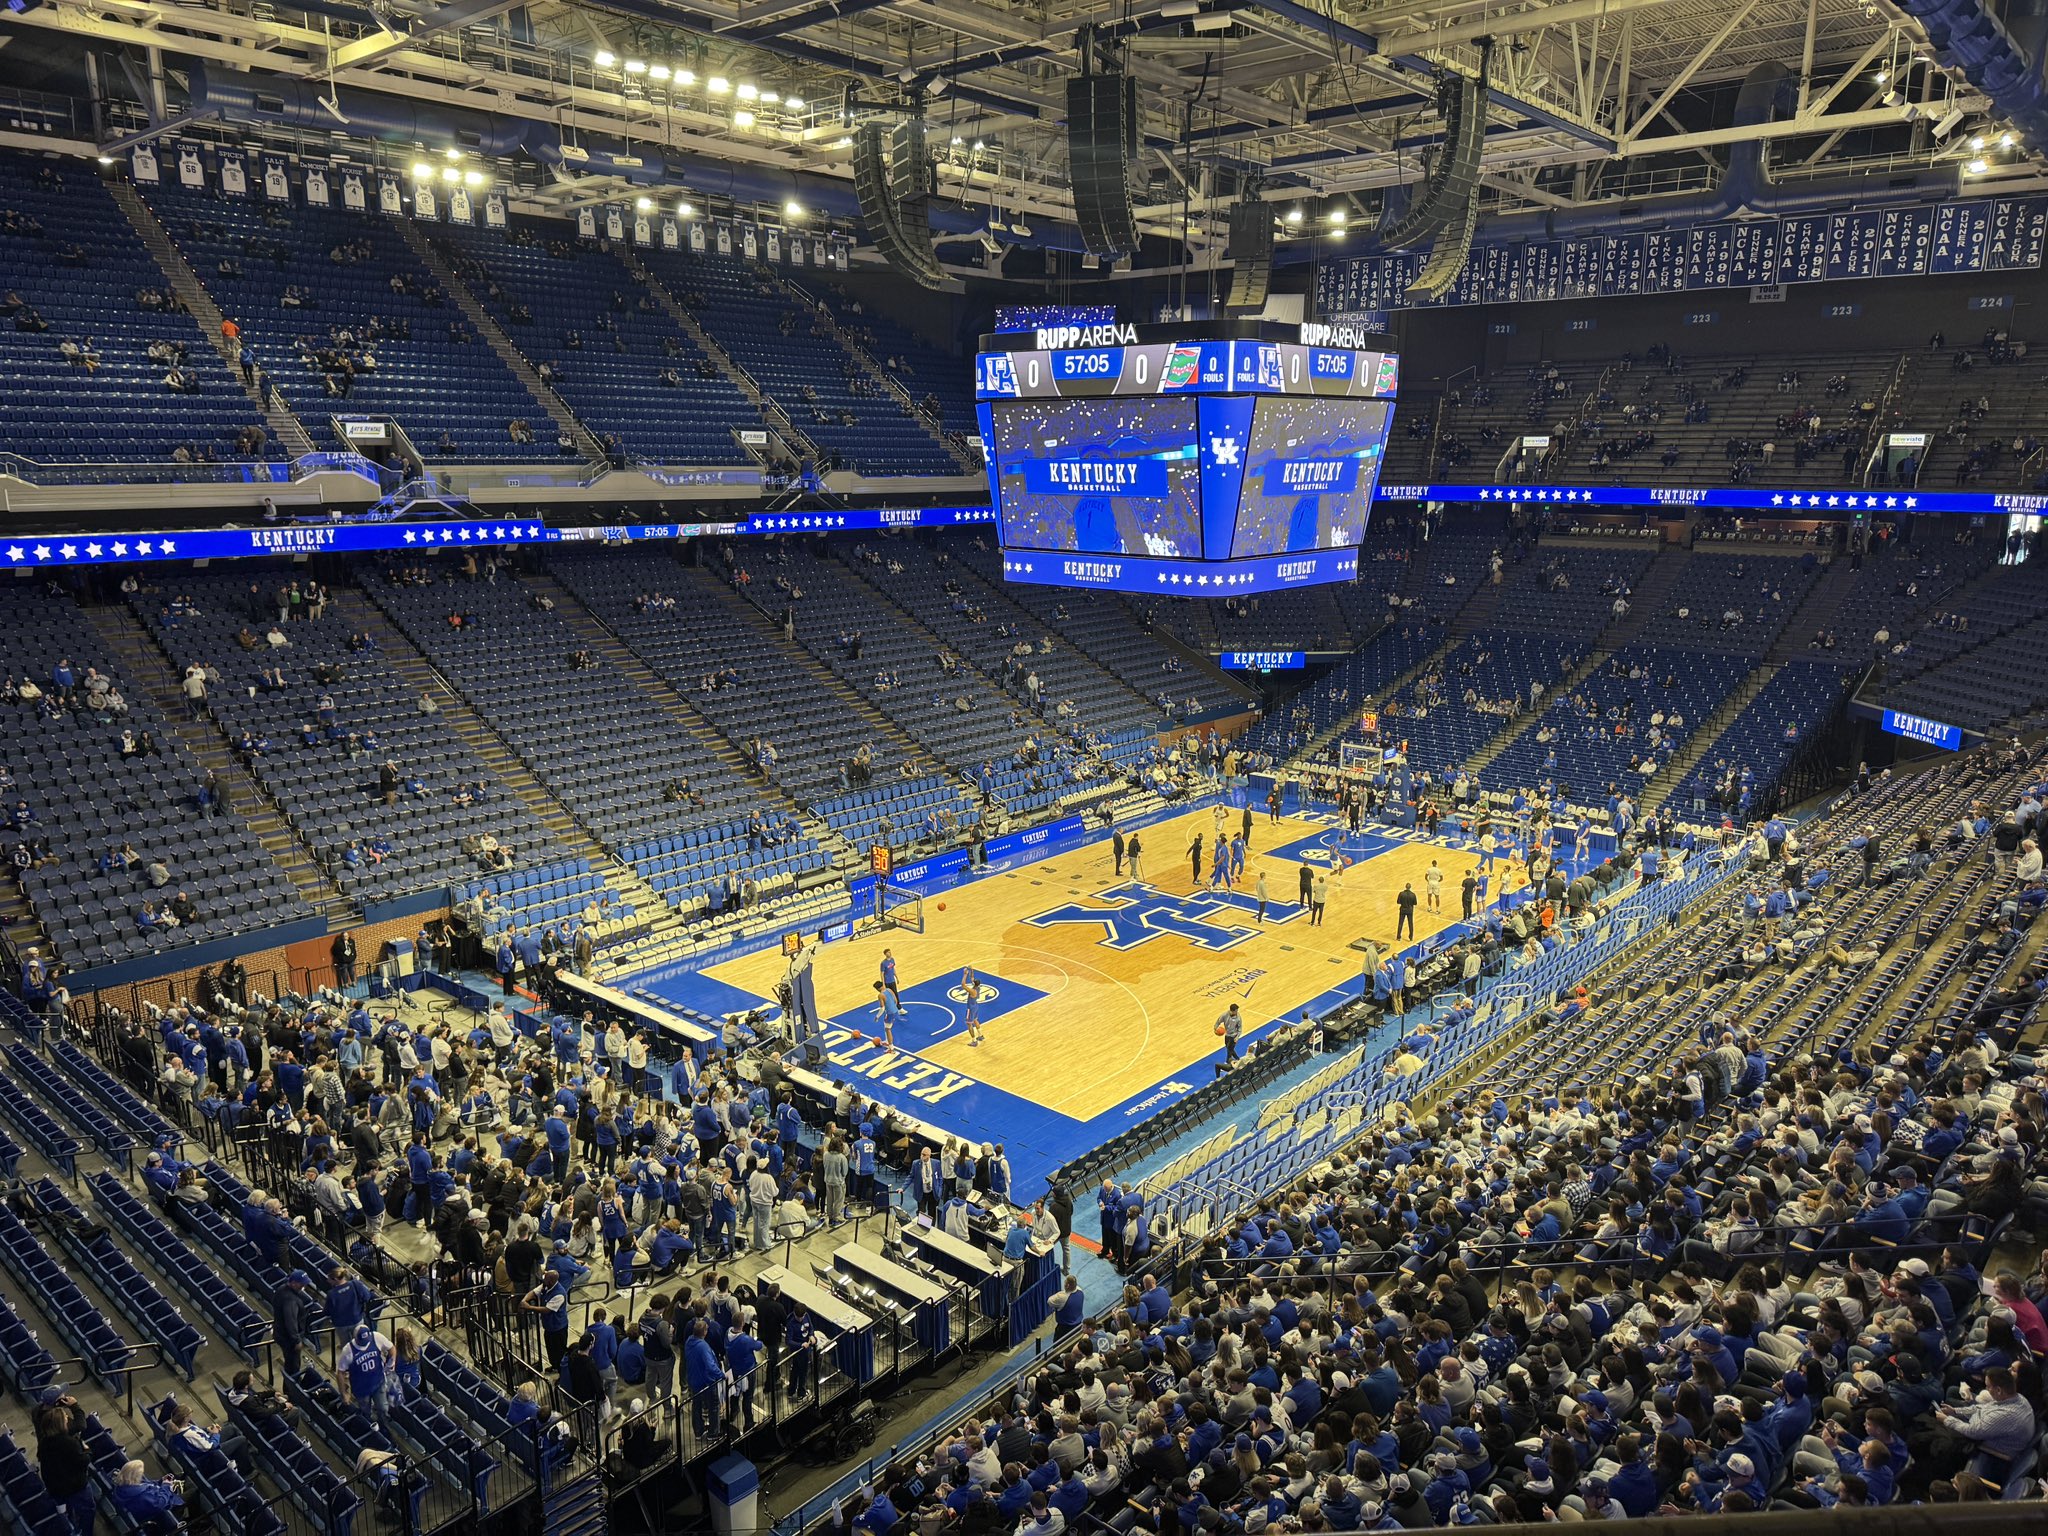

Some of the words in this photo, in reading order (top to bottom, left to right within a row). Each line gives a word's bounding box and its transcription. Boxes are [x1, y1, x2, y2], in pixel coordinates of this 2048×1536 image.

[219, 150, 245, 160] SPICER
[265, 157, 285, 165] SALE
[186, 165, 196, 174] 56
[272, 177, 280, 185] 19
[377, 172, 399, 180] BEARD
[314, 183, 320, 191] 7
[351, 187, 357, 195] 4
[386, 192, 394, 200] 12
[1957, 209, 1970, 248] RUNNER
[1991, 203, 2012, 253] NCAA
[2014, 205, 2027, 235] FINAL
[1829, 217, 1847, 264] NCAA
[1850, 218, 1861, 247] FINAL
[1880, 212, 1900, 260] NCAA
[1897, 214, 1913, 270] CHAMPION
[1936, 207, 1956, 257] NCAA
[1968, 219, 1985, 268] 2014
[2026, 214, 2045, 263] 2015
[1619, 240, 1629, 265] FINAL
[1662, 236, 1671, 263] FINAL
[1689, 230, 1704, 275] NCAA
[1732, 227, 1749, 272] NCAA
[1749, 229, 1761, 264] RUNNER
[1781, 222, 1798, 268] NCAA
[1797, 222, 1812, 278] CHAMPION
[1810, 232, 1825, 278] 1998
[1861, 228, 1876, 274] 2011
[1912, 224, 1929, 271] 2012
[2010, 238, 2022, 262] FOUR
[1499, 251, 1508, 282] RUNNER
[1524, 246, 1537, 287] NCAA
[1538, 248, 1548, 280] RUNNER
[1563, 243, 1576, 285] NCAA
[1577, 243, 1587, 293] CHAMPION
[1604, 239, 1618, 282] NCAA
[1647, 235, 1660, 279] NCAA
[1673, 245, 1684, 289] 1993
[1704, 231, 1717, 284] CHAMPION
[1716, 240, 1728, 284] 1996
[1761, 237, 1774, 281] 1997
[1847, 249, 1858, 272] FOUR
[1954, 252, 1964, 266] UP
[1349, 261, 1360, 299] NCAA
[1382, 260, 1393, 298] NCAA
[1486, 249, 1498, 290] NCAA
[1509, 260, 1519, 300] 1966
[1547, 256, 1558, 297] 1975
[1587, 251, 1598, 293] 1978
[1617, 269, 1627, 290] FOUR
[1629, 248, 1640, 291] 1984
[1660, 266, 1669, 287] FOUR
[1747, 268, 1756, 280] UP
[1318, 266, 1328, 303] NCAA
[1336, 274, 1345, 310] 1942
[1360, 262, 1369, 308] CHAMPION
[1369, 271, 1378, 308] 1948
[1394, 260, 1403, 305] CHAMPION
[1470, 262, 1479, 301] 1958
[1498, 287, 1505, 297] UP
[1831, 306, 1853, 316] 223
[1980, 297, 2003, 308] 224
[1330, 313, 1369, 322] OFFICIAL
[1572, 320, 1589, 330] 221
[1692, 314, 1711, 323] 223
[1036, 327, 1081, 350] RUPP
[1080, 322, 1138, 347] ARENA
[1300, 322, 1331, 347] RUPP
[1329, 325, 1366, 350] ARENA
[1494, 325, 1510, 334] 221
[1028, 360, 1039, 388] 0
[1064, 353, 1110, 374] 57:05
[1135, 353, 1148, 385] 0
[1209, 357, 1217, 372] 0
[1243, 357, 1251, 372] 0
[1291, 353, 1300, 384] 0
[1317, 353, 1347, 374] 57:05
[1361, 359, 1369, 388] 0
[1203, 372, 1224, 383] FOULS
[1237, 372, 1255, 383] FOULS
[1049, 463, 1137, 483] KENTUCKY
[1282, 461, 1343, 484] KENTUCKY
[1067, 483, 1121, 492] BASKETBALL
[1293, 482, 1329, 491] BASKETBALL
[1381, 486, 1429, 496] KENTUCKY
[1650, 489, 1708, 501] KENTUCKY
[1993, 495, 2048, 508] KENTUCKY
[880, 509, 922, 522] KENTUCKY
[251, 528, 336, 547] KENTUCKY
[644, 527, 669, 536] 57:05
[1064, 561, 1122, 578] KENTUCKY
[1075, 575, 1110, 583] BASKETBALL
[1277, 560, 1317, 578] KENTUCKY
[1233, 652, 1293, 664] KENTUCKY
[1364, 720, 1375, 729] 30
[1893, 712, 1950, 741] KENTUCKY
[1902, 730, 1936, 744] BASKETBALL
[1022, 829, 1049, 844] KENTUCKY
[874, 857, 889, 871] 30
[896, 865, 928, 882] KENTUCKY
[827, 922, 849, 938] KENTUCKY
[1238, 968, 1268, 984] RUPP
[1201, 980, 1240, 999] ARENA
[1124, 1090, 1170, 1116] HealthCare
[863, 1143, 874, 1153] 23
[603, 1207, 615, 1216] 23
[355, 1350, 378, 1365] KENTUCKY
[361, 1359, 376, 1372] 00
[908, 1478, 925, 1498] 00
